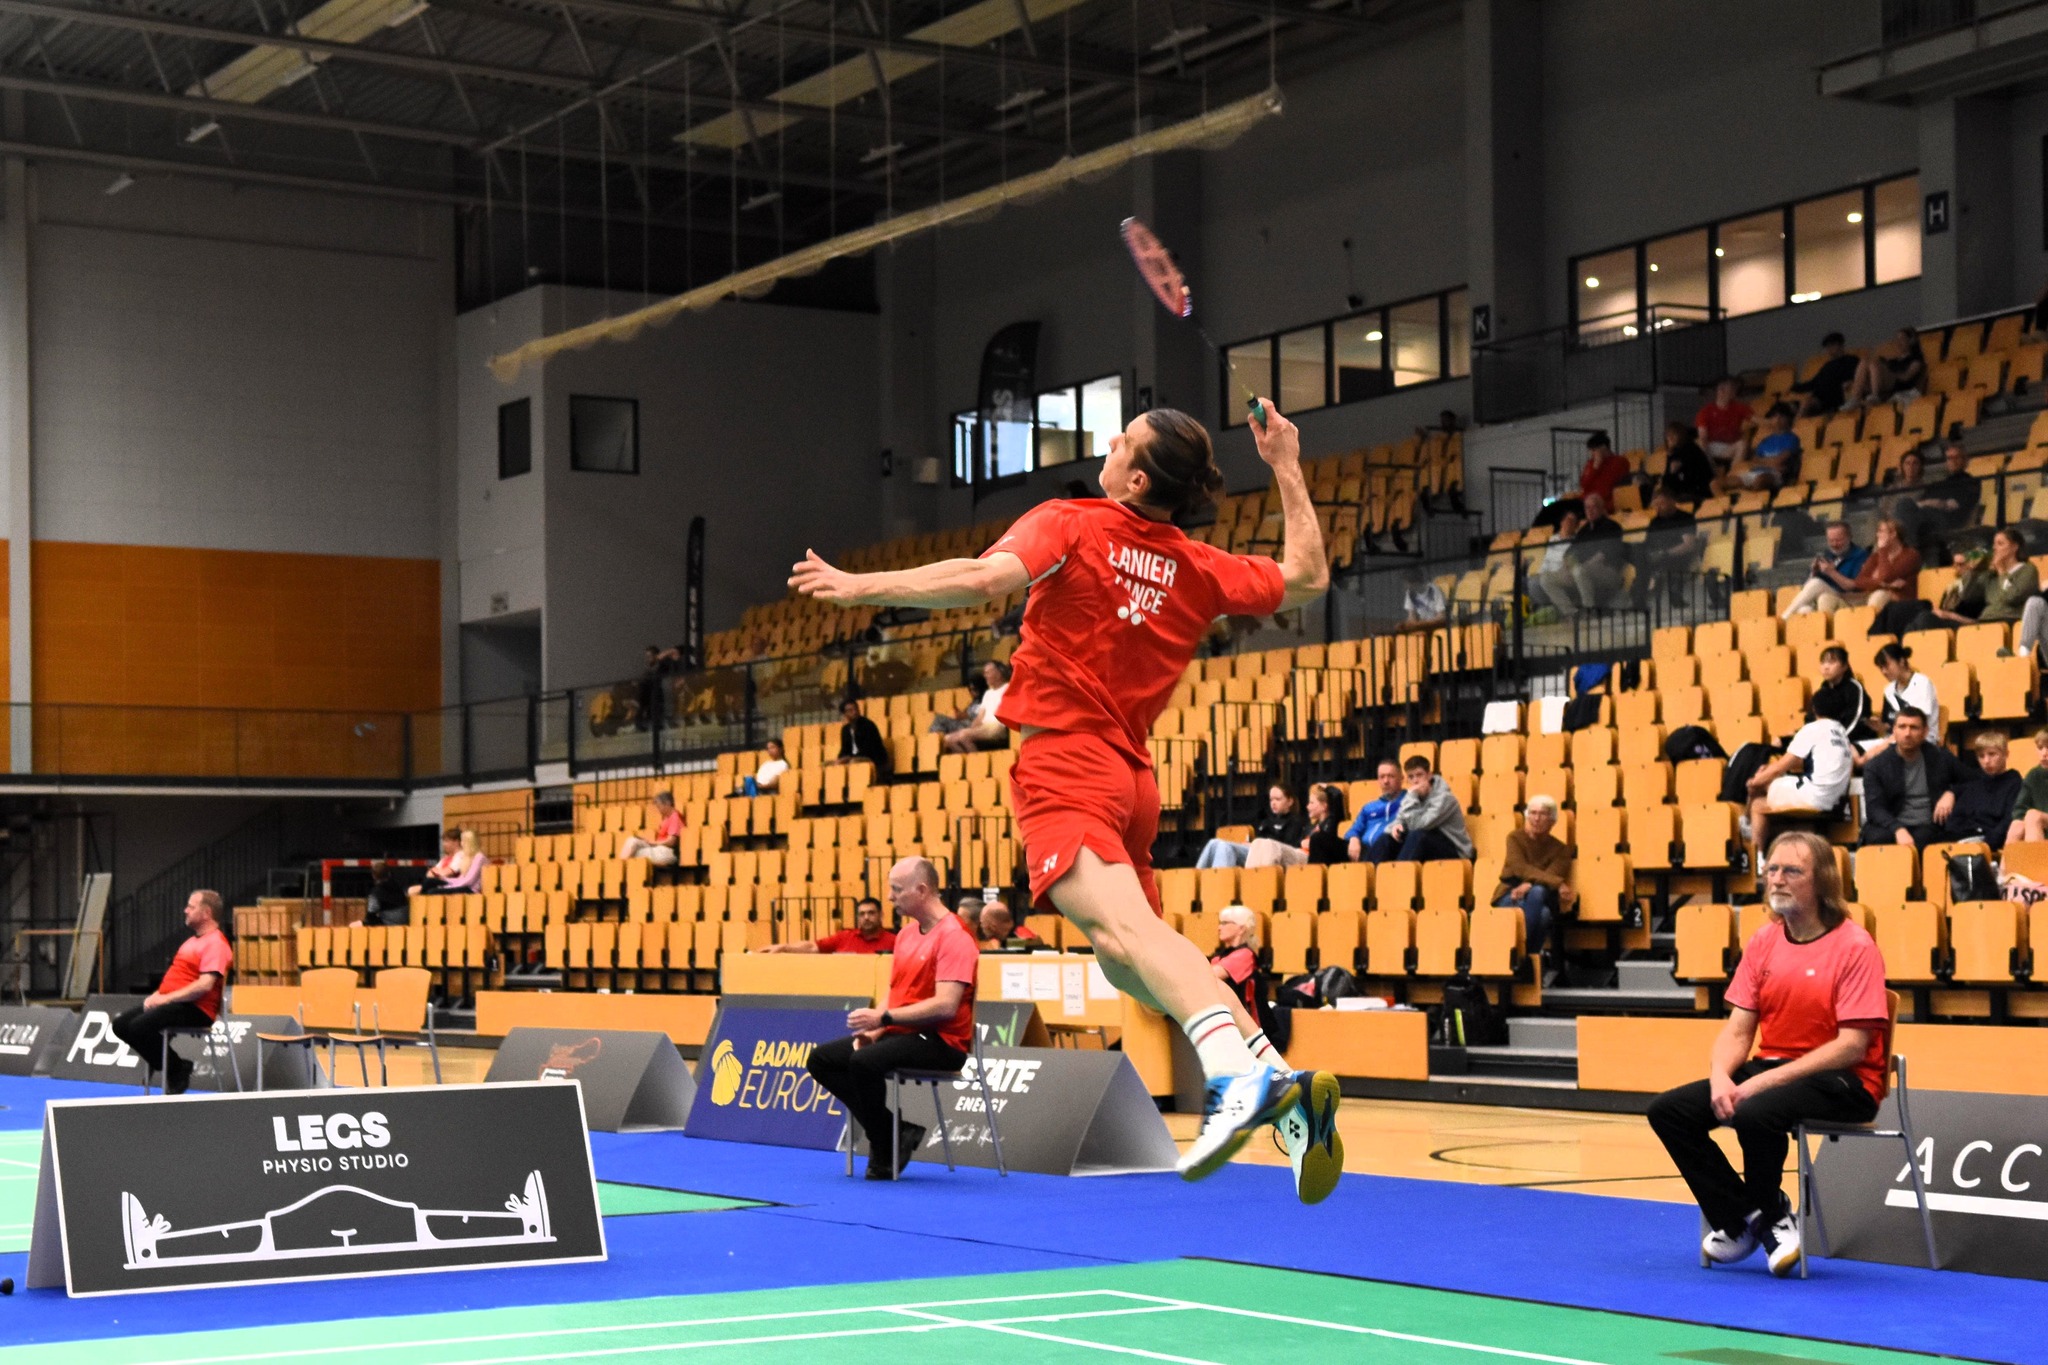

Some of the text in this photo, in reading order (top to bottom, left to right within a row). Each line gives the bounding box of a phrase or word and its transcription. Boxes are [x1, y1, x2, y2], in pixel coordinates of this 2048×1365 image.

[1929, 201, 1945, 225] H
[1475, 313, 1487, 334] K
[751, 1040, 818, 1068] BADMI
[272, 1111, 392, 1152] LEGS
[262, 1153, 409, 1175] PHYSIO STUDIO
